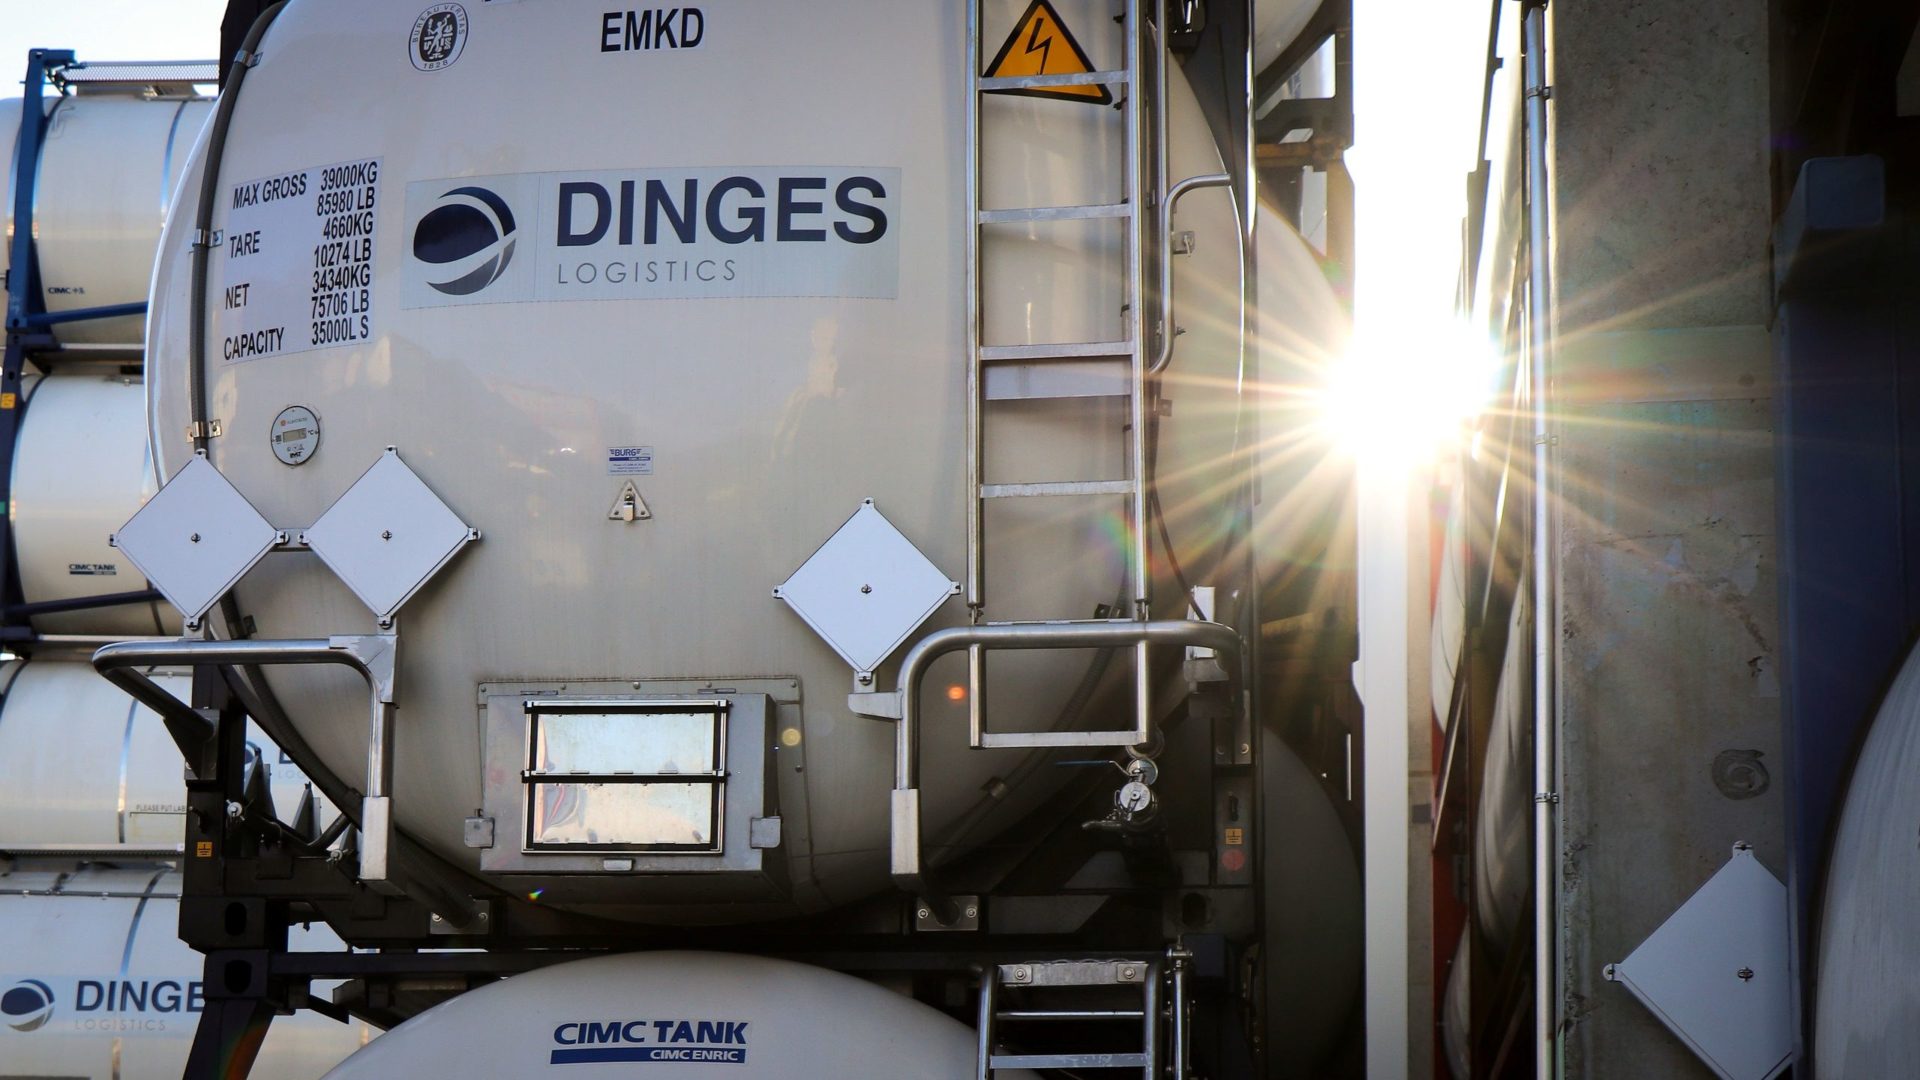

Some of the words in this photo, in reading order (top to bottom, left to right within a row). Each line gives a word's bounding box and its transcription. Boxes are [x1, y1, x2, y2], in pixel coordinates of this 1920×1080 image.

[412, 6, 440, 43] BUREAU
[444, 4, 467, 35] VERITAS
[600, 7, 704, 52] EMKD
[423, 59, 449, 69] 1828
[233, 182, 260, 210] MAX
[262, 172, 307, 203] GROSS
[321, 161, 378, 192] 39000KG
[317, 189, 353, 217] 85980
[357, 186, 376, 211] LB
[557, 176, 888, 246] DINGES
[230, 230, 262, 259] TARE
[323, 211, 374, 240] 4660KG
[314, 241, 350, 268] 10274
[353, 237, 372, 263] LB
[225, 283, 250, 310] NET
[312, 263, 371, 294] 34340KG
[558, 259, 736, 284] LOGISTICS
[311, 291, 348, 319] 75706
[351, 289, 370, 313] LB
[224, 327, 285, 361] CAPACITY
[312, 317, 357, 346] 35000L
[360, 315, 369, 339] S
[69, 563, 92, 571] CIMC
[93, 563, 117, 571] TANK
[173, 804, 186, 812] LAB
[75, 980, 205, 1013] DINGE
[75, 1018, 166, 1032] LOGISTICS
[553, 1021, 647, 1045] CIMC
[653, 1020, 749, 1045] TANK
[650, 1049, 691, 1060] CIMC
[692, 1050, 739, 1061] ENRIC
